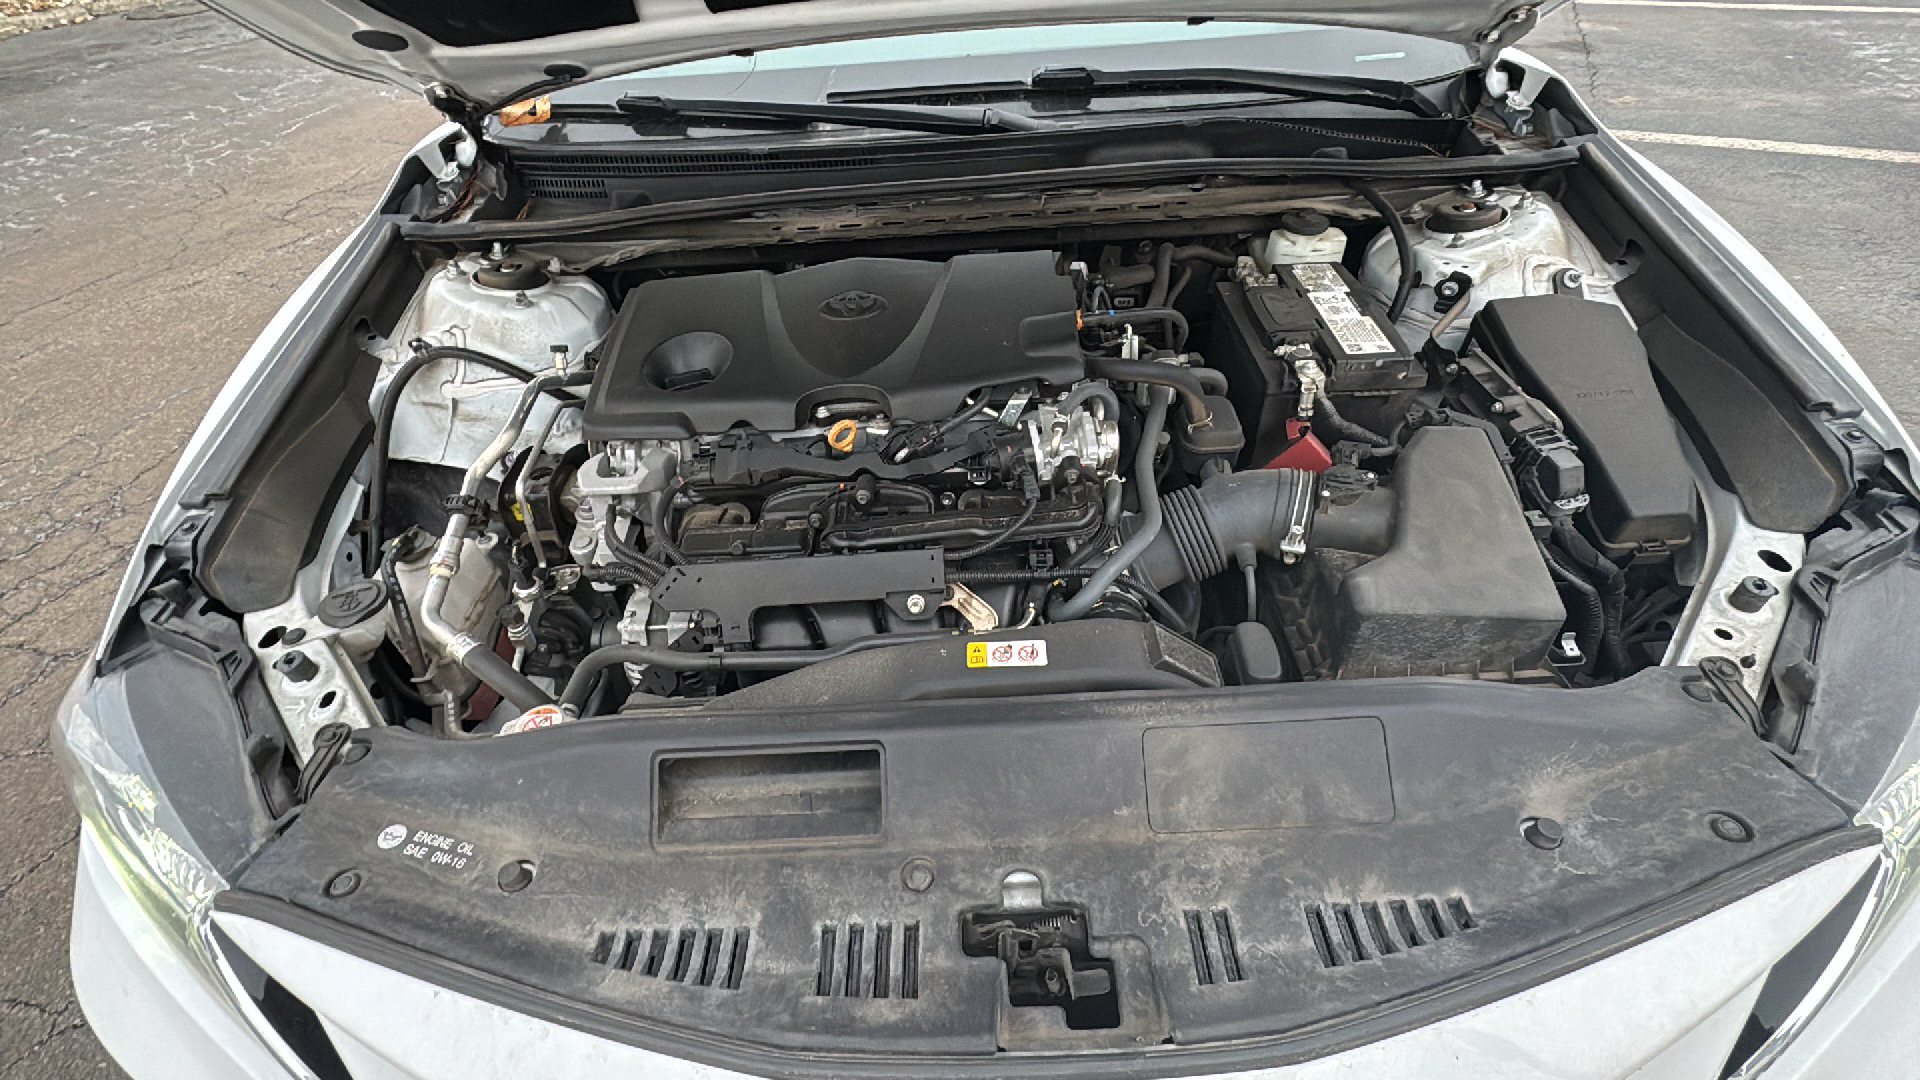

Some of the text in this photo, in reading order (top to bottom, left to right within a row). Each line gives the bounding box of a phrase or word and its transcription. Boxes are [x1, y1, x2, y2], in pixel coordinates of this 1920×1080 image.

[403, 843, 429, 859] SAE
[413, 830, 475, 856] ENGINE OIL
